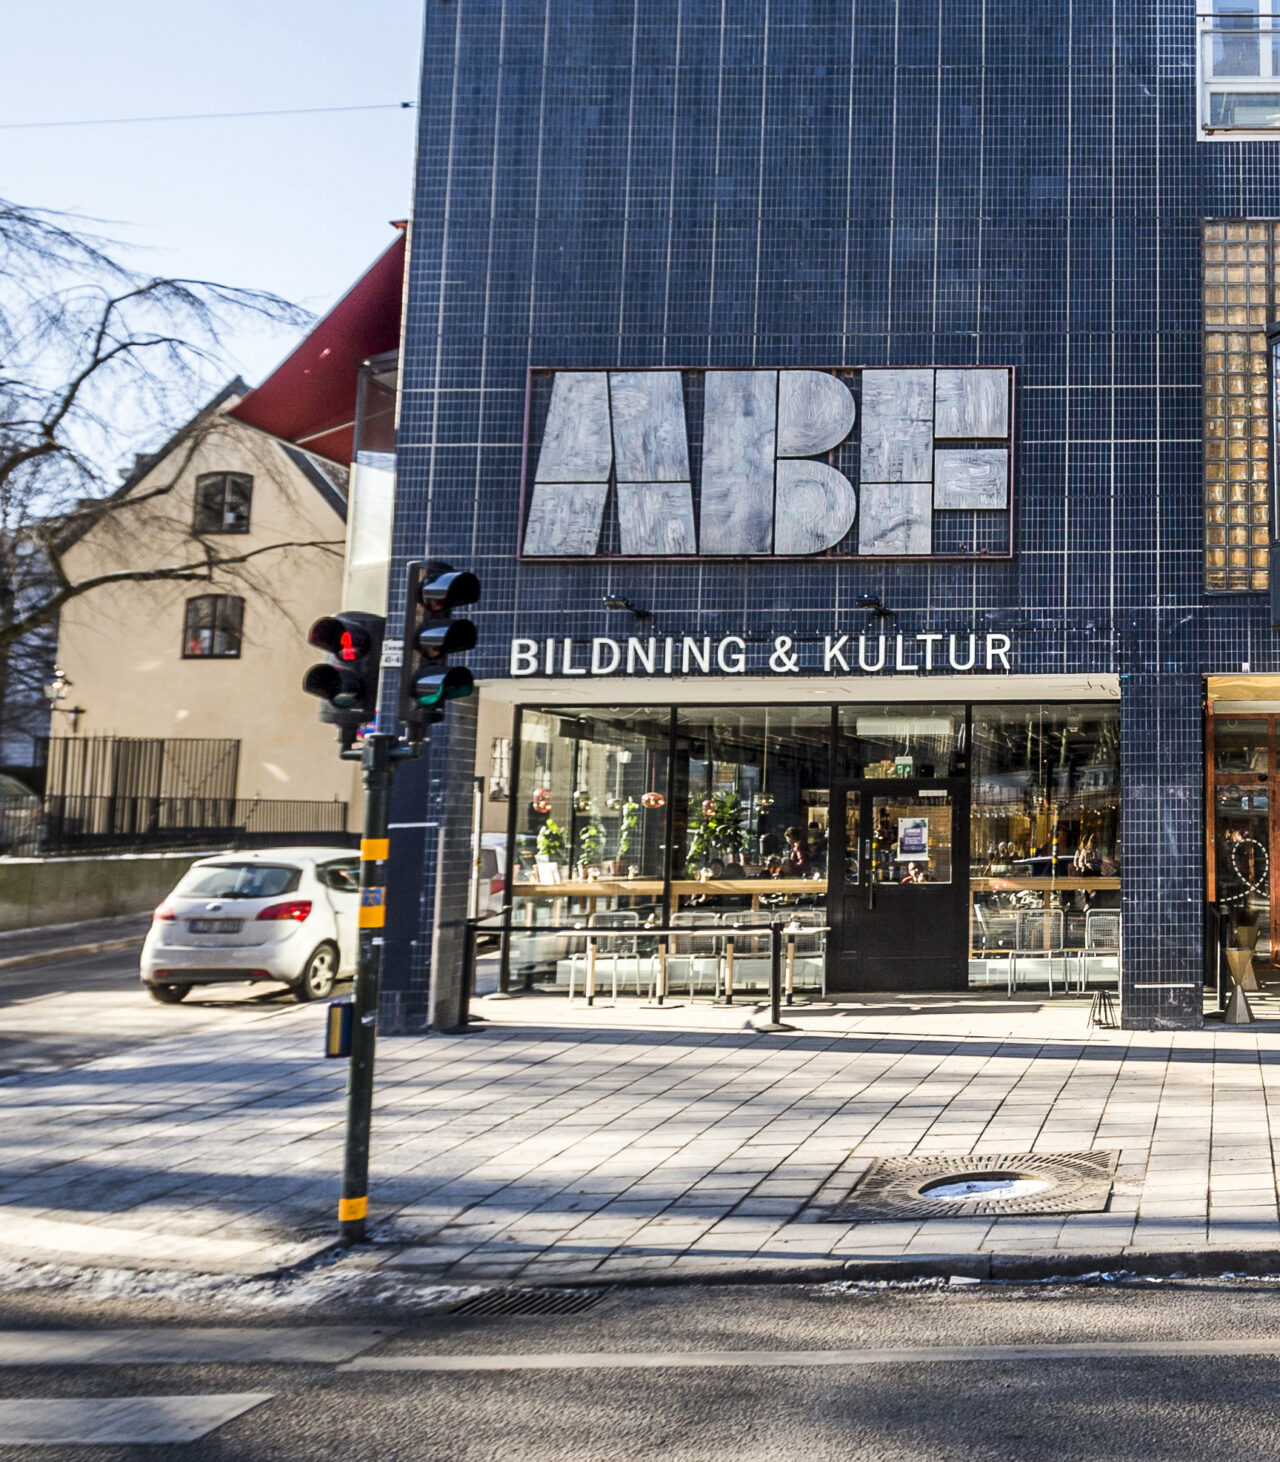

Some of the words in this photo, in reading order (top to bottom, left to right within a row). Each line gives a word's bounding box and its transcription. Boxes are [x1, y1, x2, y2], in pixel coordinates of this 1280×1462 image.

[521, 368, 1009, 556] ABF
[510, 636, 747, 675] BILDNING
[769, 635, 800, 673] &
[823, 633, 1012, 672] KULTUR
